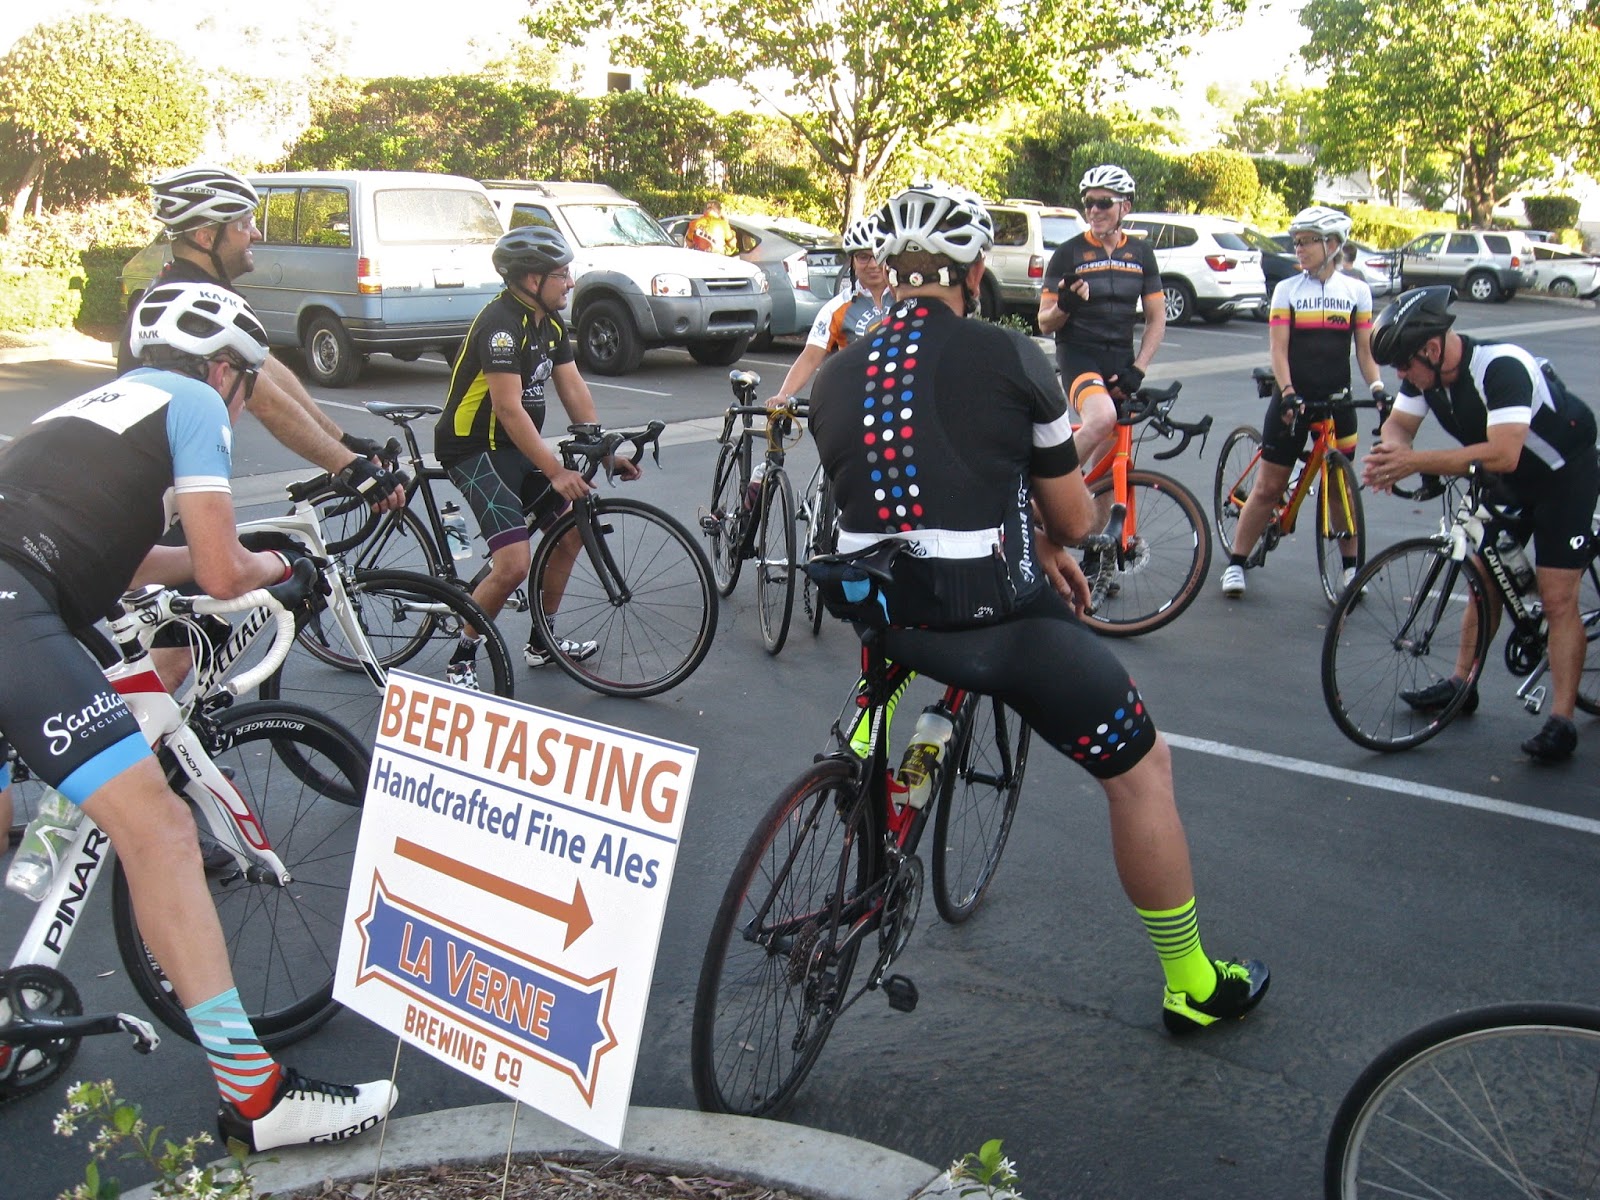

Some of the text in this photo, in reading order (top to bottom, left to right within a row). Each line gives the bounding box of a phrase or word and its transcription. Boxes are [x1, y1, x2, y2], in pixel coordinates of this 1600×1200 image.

[194, 187, 217, 195] GIRO
[199, 290, 238, 308] KASK
[1296, 297, 1351, 310] CALIFORNIA
[138, 330, 159, 339] KASK
[80, 708, 129, 738] CYCLING
[235, 720, 306, 736] BONTRAGER
[177, 744, 202, 778] ONDA
[379, 683, 682, 824] BEER TASTING
[372, 757, 660, 889] Handcrafted Fine Ales
[398, 921, 433, 984] LA
[404, 1003, 488, 1071] BREWING
[308, 1115, 378, 1144] GIRO
